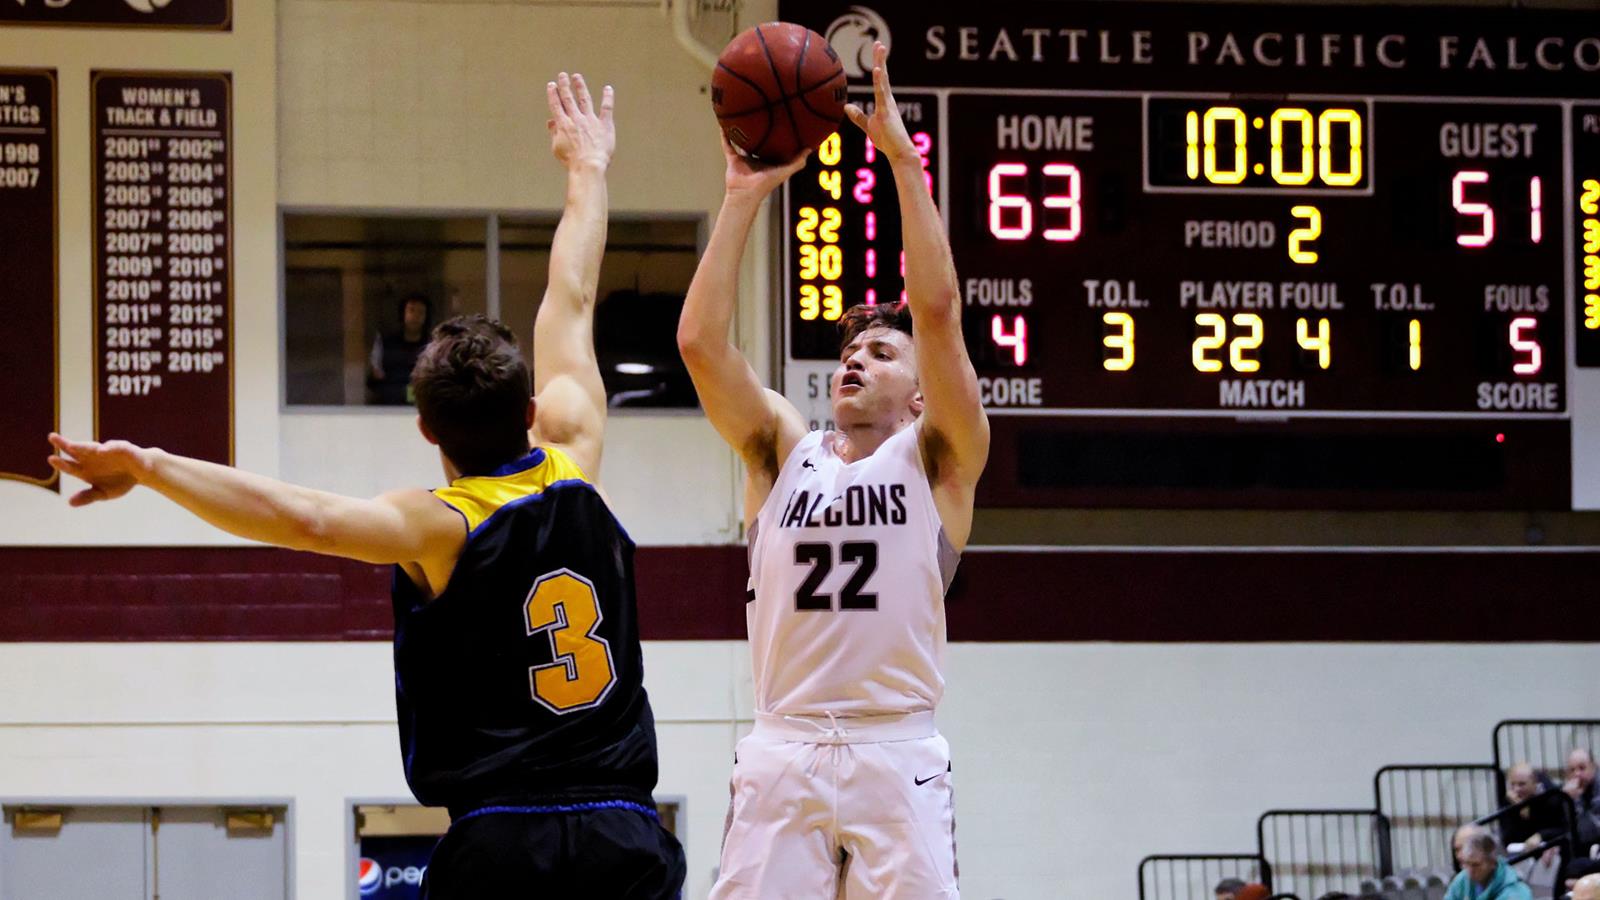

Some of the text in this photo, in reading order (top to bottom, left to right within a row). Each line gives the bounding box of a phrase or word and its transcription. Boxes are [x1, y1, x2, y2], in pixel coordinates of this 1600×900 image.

[925, 26, 1600, 71] SEATTLE PACIFIC FALCO
[0, 105, 40, 124] TICS
[122, 87, 201, 107] WOMEN'S
[106, 107, 217, 128] TRACK & FIELD
[997, 114, 1093, 151] HOME
[0, 143, 40, 164] 998
[1185, 106, 1363, 187] 10:00
[1439, 122, 1537, 158] GUEST
[818, 167, 877, 204] 4 2
[987, 161, 1082, 241] 63
[796, 206, 877, 243] 22 1
[1451, 170, 1542, 248] 51
[1184, 220, 1276, 248] PERIOD
[1287, 205, 1322, 265] 2
[799, 244, 843, 281] 30
[864, 248, 877, 278] 1
[799, 284, 843, 321] 33
[966, 278, 1033, 307] FOULS
[1083, 279, 1149, 308] T.O.L.
[1180, 280, 1344, 310] PLAYER FOUL
[1370, 283, 1435, 311] T.O.L.
[1484, 284, 1549, 313] FOULS
[991, 313, 1028, 367] 4
[1102, 311, 1136, 372] 3
[1191, 312, 1331, 373] 22 4
[1408, 318, 1422, 371] 1
[1509, 316, 1542, 375] 5
[978, 377, 1042, 406] CORE
[1219, 379, 1305, 407] MATCH
[1477, 382, 1558, 410] SCORE
[793, 539, 879, 612] 22
[523, 567, 617, 715] 3
